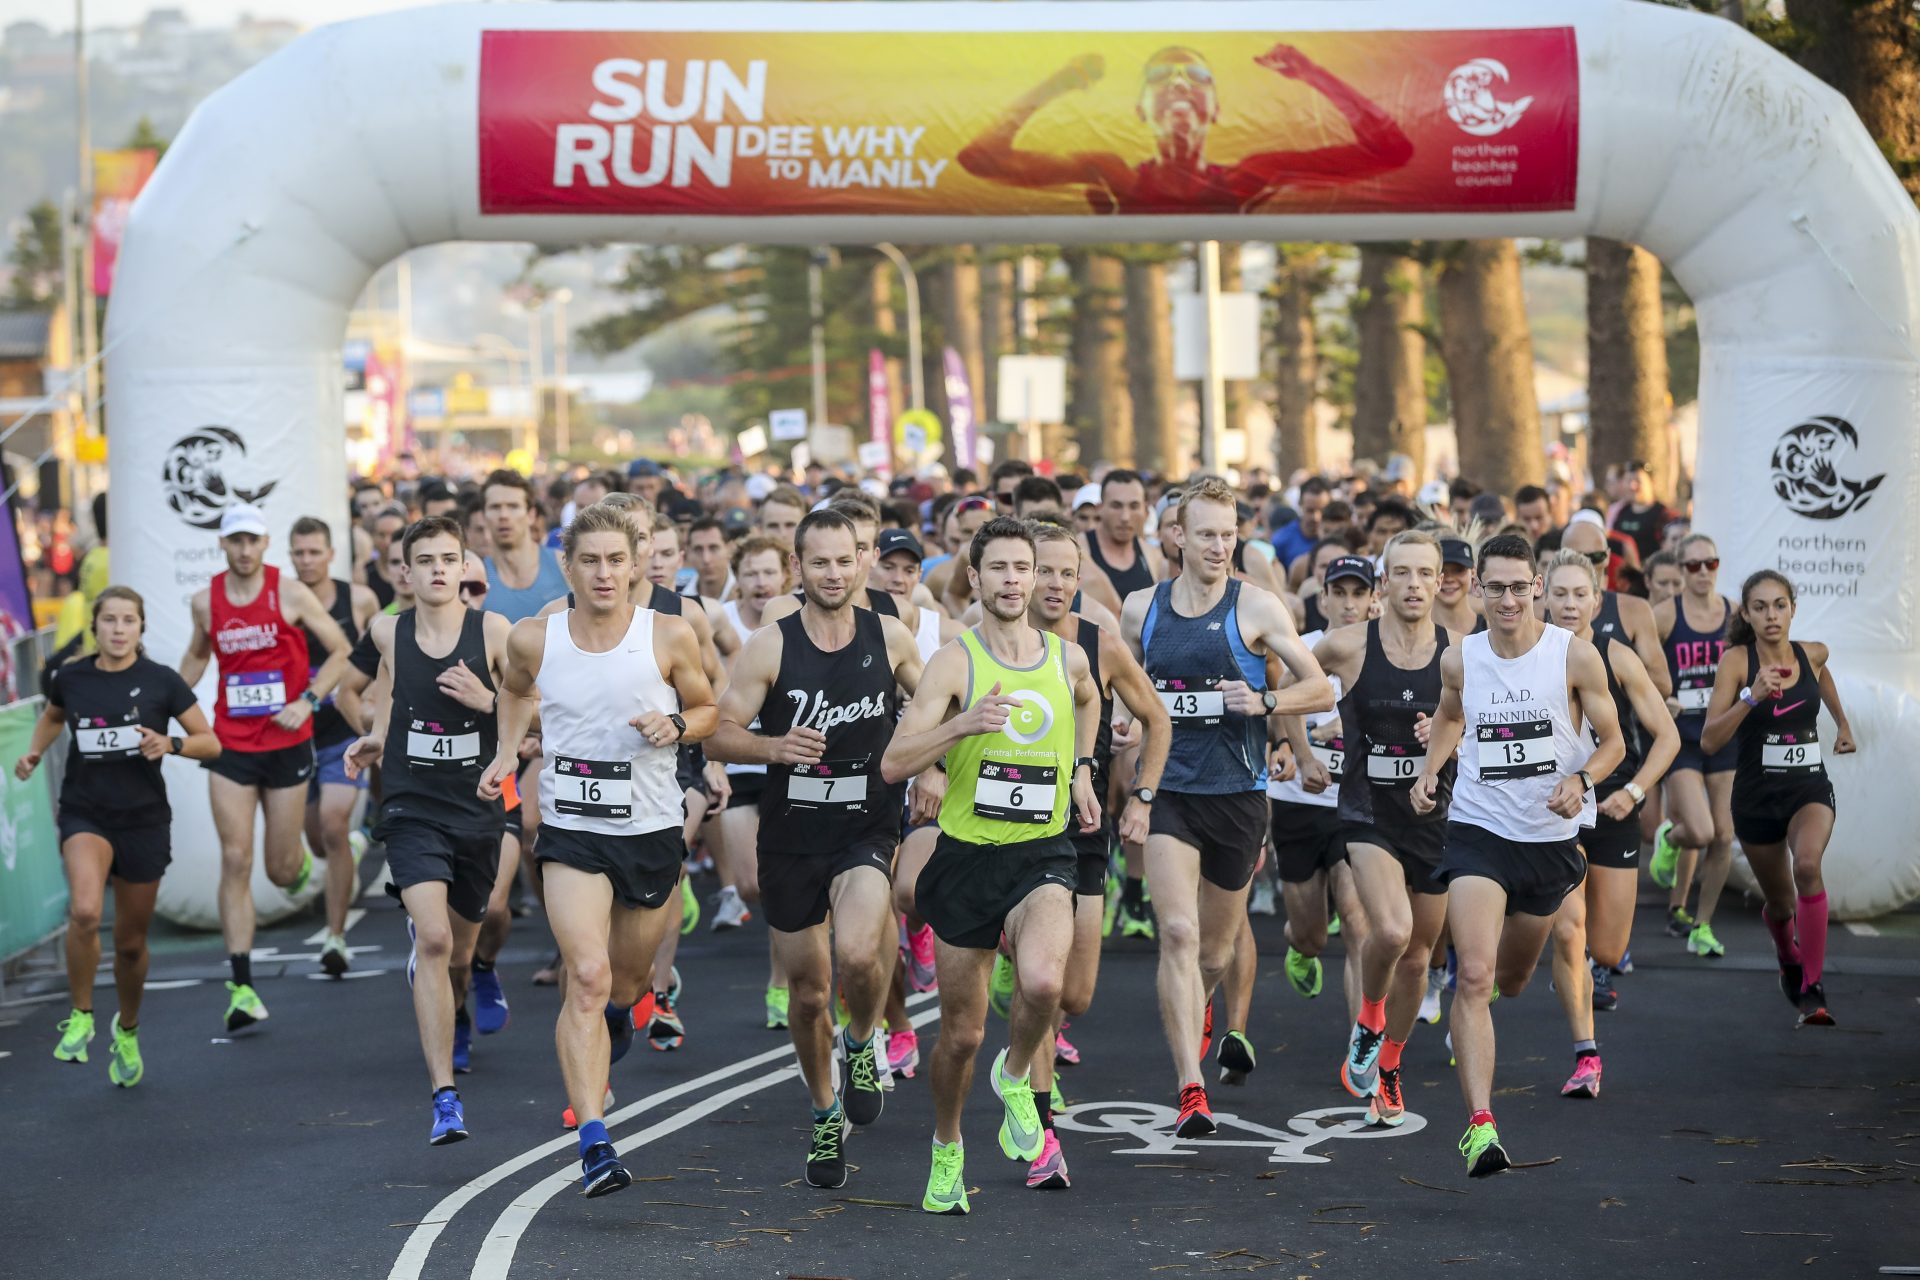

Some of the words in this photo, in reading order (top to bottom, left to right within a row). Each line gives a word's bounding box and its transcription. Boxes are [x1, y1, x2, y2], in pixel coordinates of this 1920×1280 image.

[589, 58, 768, 122] SUN
[737, 126, 813, 157] DEE
[823, 126, 926, 157] WHY
[1452, 142, 1519, 157] northern
[553, 124, 734, 188] RUN
[1452, 158, 1518, 172] beaches
[766, 158, 802, 181] TO
[809, 159, 948, 189] MANLY
[1455, 173, 1513, 187] council
[1778, 533, 1866, 551] northern
[1778, 554, 1865, 575] beaches
[1797, 579, 1858, 597] ouncil
[1675, 640, 1729, 671] DELT
[236, 688, 273, 704] 1543
[1174, 694, 1198, 715] 43
[1491, 689, 1534, 704] L.A.D.
[787, 690, 884, 737] Vipers
[1478, 708, 1549, 724] RUNNING
[97, 731, 119, 747] 42
[432, 738, 452, 757] 41
[983, 747, 1012, 757] Central
[1015, 750, 1060, 758] Performanc
[1328, 753, 1344, 770] 5
[1503, 742, 1526, 764] 13
[1783, 747, 1806, 764] 49
[1393, 759, 1414, 777] 10
[1536, 763, 1552, 772] 10KM
[580, 780, 602, 802] 16
[823, 781, 835, 800] 7
[1010, 786, 1024, 807] 6
